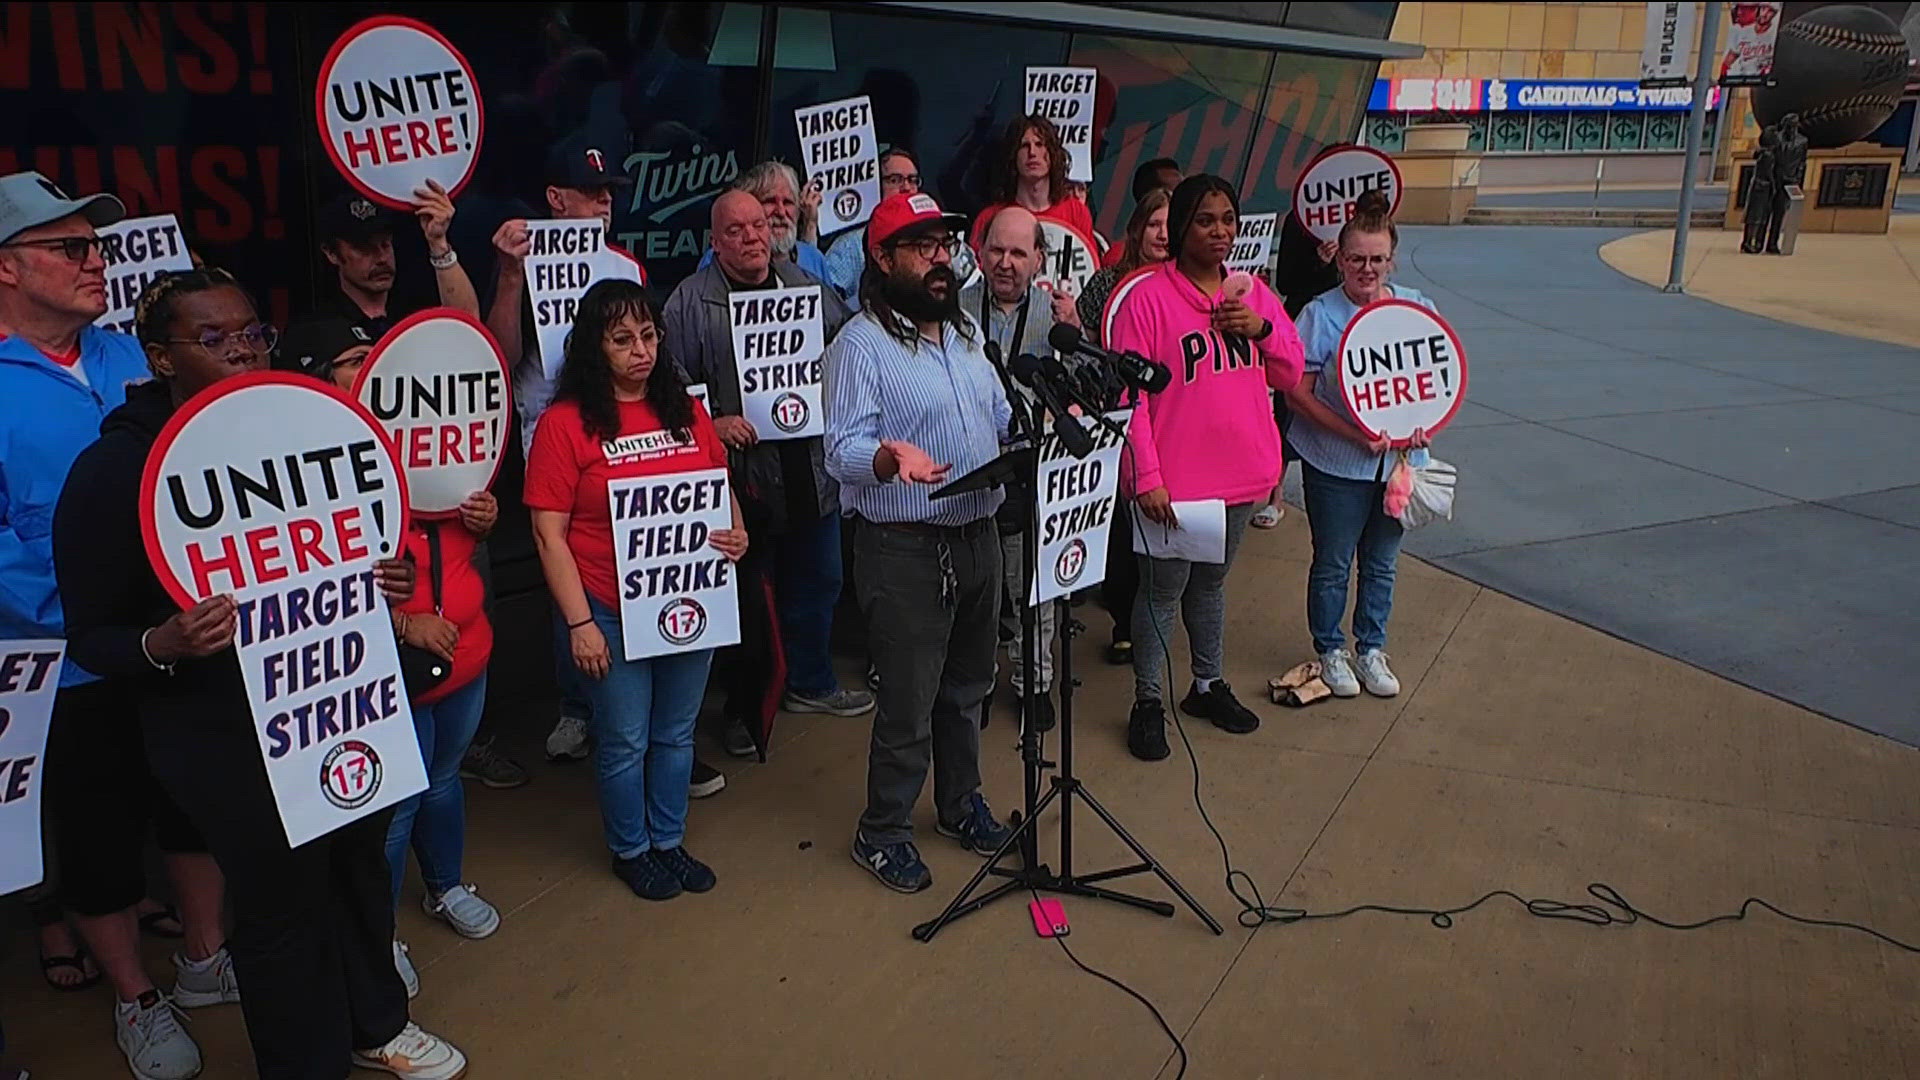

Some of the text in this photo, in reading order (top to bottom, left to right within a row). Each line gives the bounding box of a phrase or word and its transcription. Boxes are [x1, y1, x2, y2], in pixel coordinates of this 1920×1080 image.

[332, 69, 467, 122] UNITE
[1028, 73, 1094, 93] TARGET
[1518, 86, 1617, 107] CARDINALS
[799, 103, 869, 138] TARGET
[1033, 98, 1080, 118] FIELD
[343, 112, 472, 168] HERE!
[811, 135, 860, 166] FIELD
[622, 144, 739, 214] Twins
[811, 159, 875, 192] STRIKE
[1303, 169, 1391, 204] UNITE
[617, 229, 709, 259] TEA
[536, 262, 590, 291] FIELD
[733, 294, 819, 327] TARGET
[744, 329, 805, 360] FIELD
[1347, 334, 1449, 378] UNITE
[370, 371, 501, 421] UNITE
[743, 359, 823, 394] STRIKE
[1352, 368, 1452, 412] HERE!
[780, 403, 800, 424] 17
[166, 439, 385, 529] UNITE
[613, 478, 725, 520] TARGET
[1046, 459, 1102, 504] FIELD
[628, 521, 708, 561] FIELD
[1043, 496, 1112, 546] STRIKE
[185, 499, 390, 599] HERE!
[1061, 551, 1080, 576] 17
[624, 558, 728, 601] STRIKE
[238, 570, 376, 648] TARGET
[668, 610, 696, 635] 17
[262, 630, 365, 702] FIELD
[265, 674, 398, 760] STRIKE
[332, 756, 365, 796] 17
